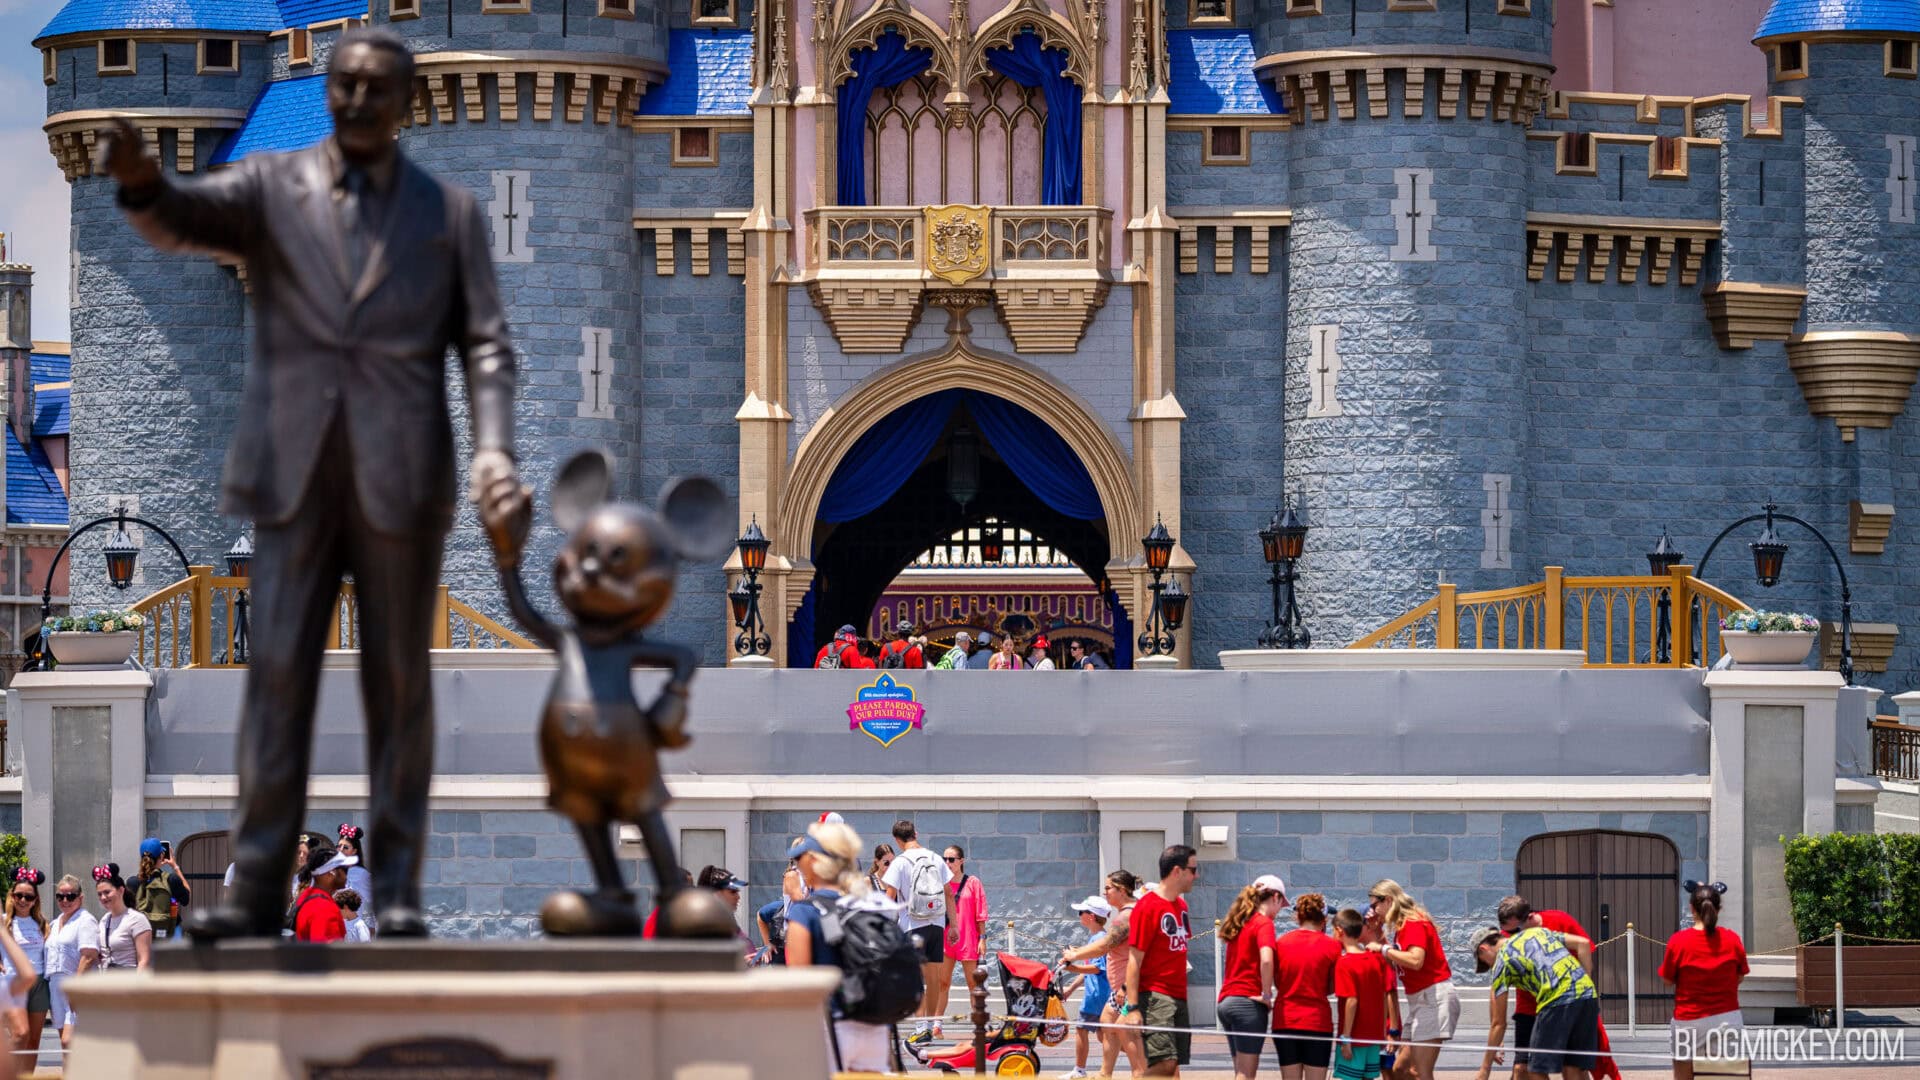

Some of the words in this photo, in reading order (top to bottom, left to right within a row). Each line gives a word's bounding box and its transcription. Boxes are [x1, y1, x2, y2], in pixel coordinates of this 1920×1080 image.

[854, 702, 882, 712] PLEASE
[885, 701, 918, 711] PARDON
[856, 710, 872, 720] OUR
[874, 709, 893, 717] PIXIE
[896, 710, 915, 720] DUST
